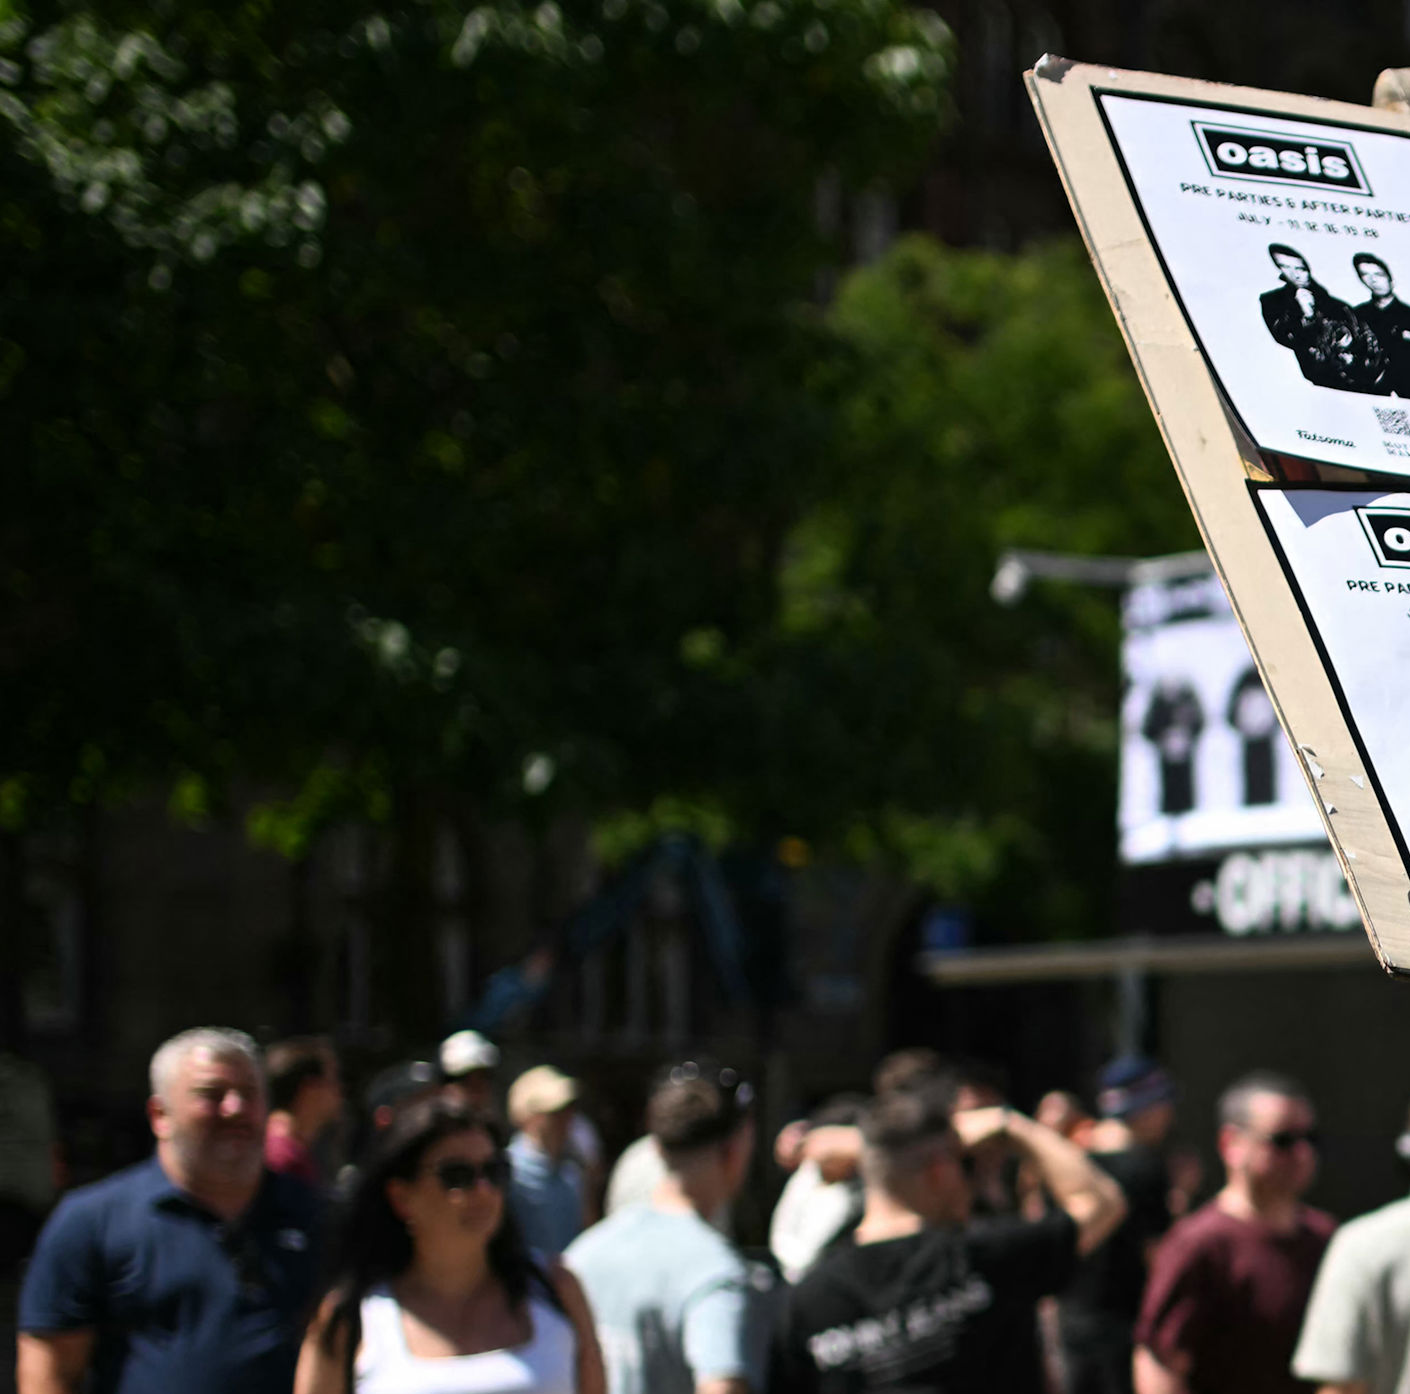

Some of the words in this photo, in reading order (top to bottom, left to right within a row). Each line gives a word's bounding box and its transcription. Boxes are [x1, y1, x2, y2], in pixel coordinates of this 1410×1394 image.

[1216, 141, 1350, 179] oasis
[1179, 182, 1211, 196] PRE
[1215, 188, 1282, 208] PARTIES
[1302, 199, 1350, 214] AFTER
[1346, 579, 1381, 593] PRE
